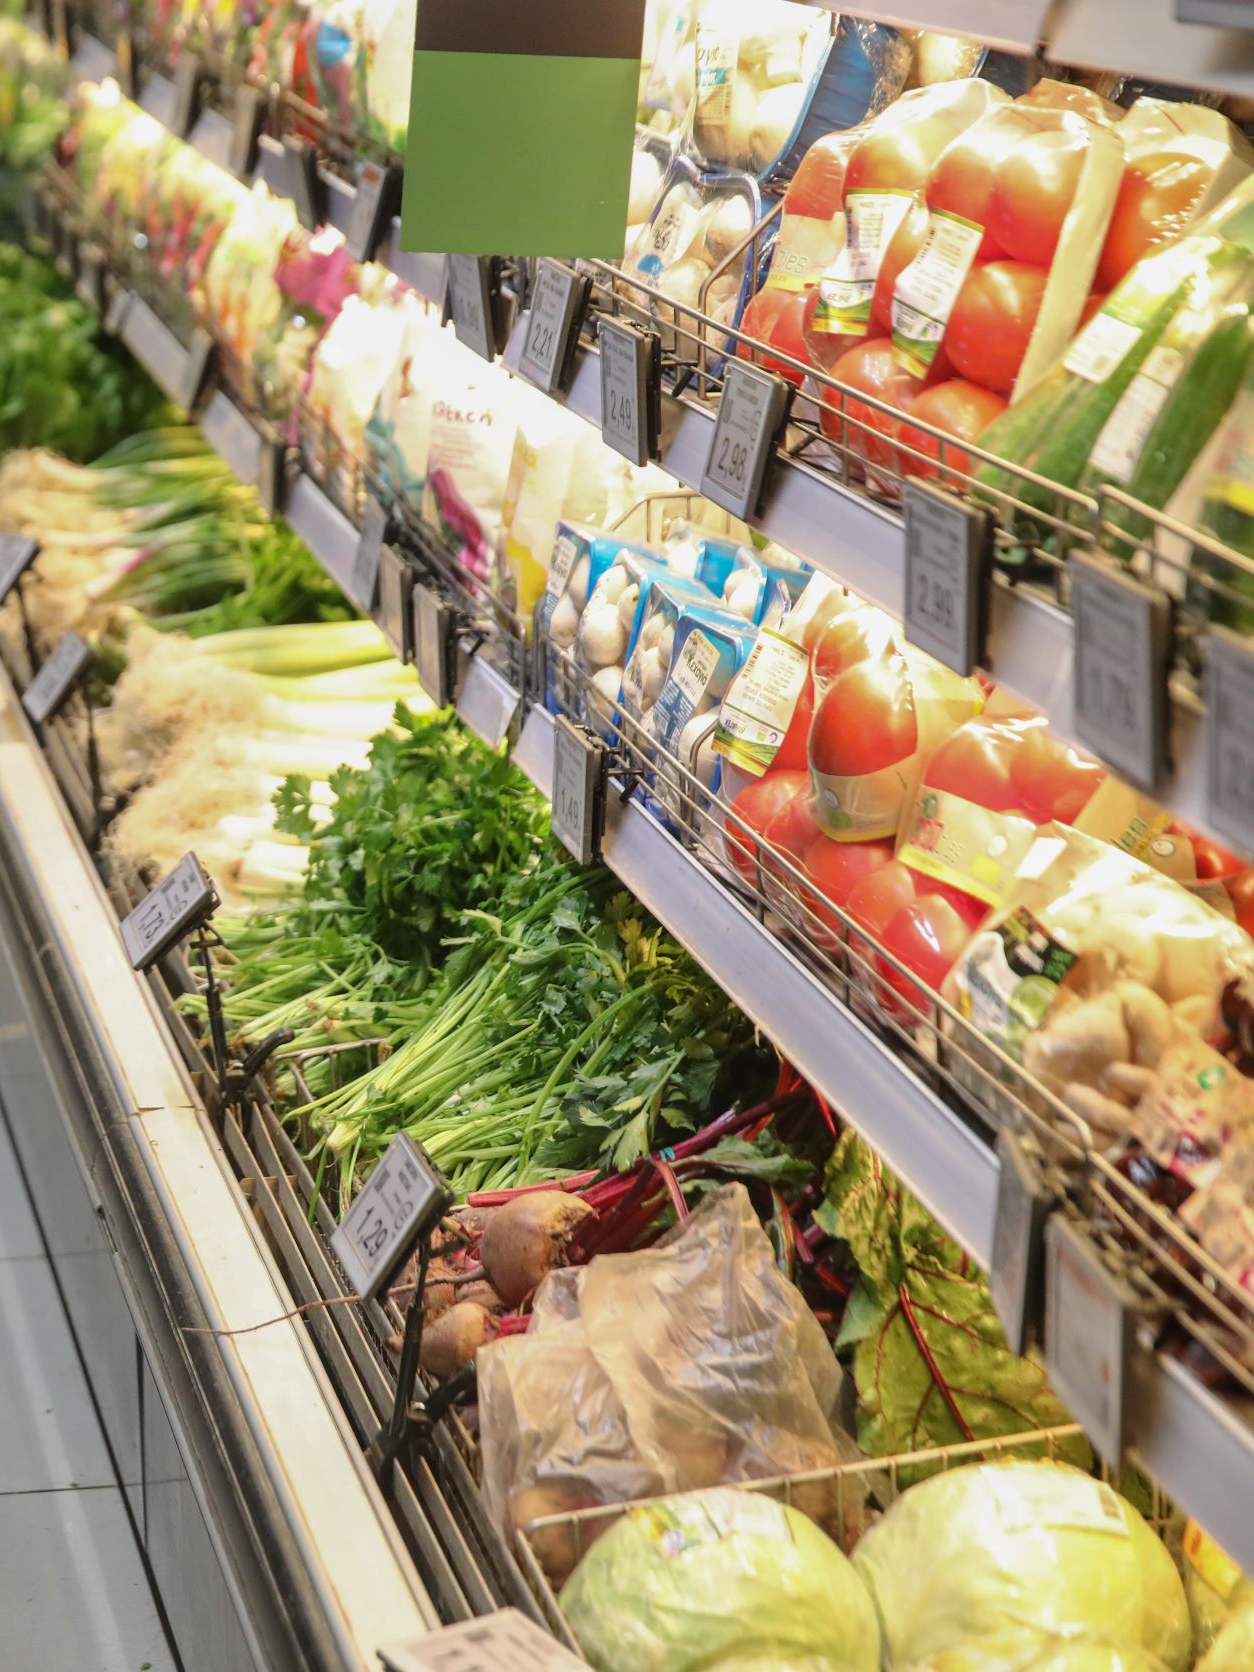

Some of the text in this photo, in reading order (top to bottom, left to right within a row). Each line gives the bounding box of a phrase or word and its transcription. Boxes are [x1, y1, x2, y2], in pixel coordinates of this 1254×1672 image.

[531, 322, 554, 357] 2,21
[610, 389, 633, 431] 2,49
[717, 436, 748, 482] 2,98
[560, 786, 579, 829] 1,49
[138, 903, 165, 940] 1,73
[356, 1206, 389, 1257] 1,29
